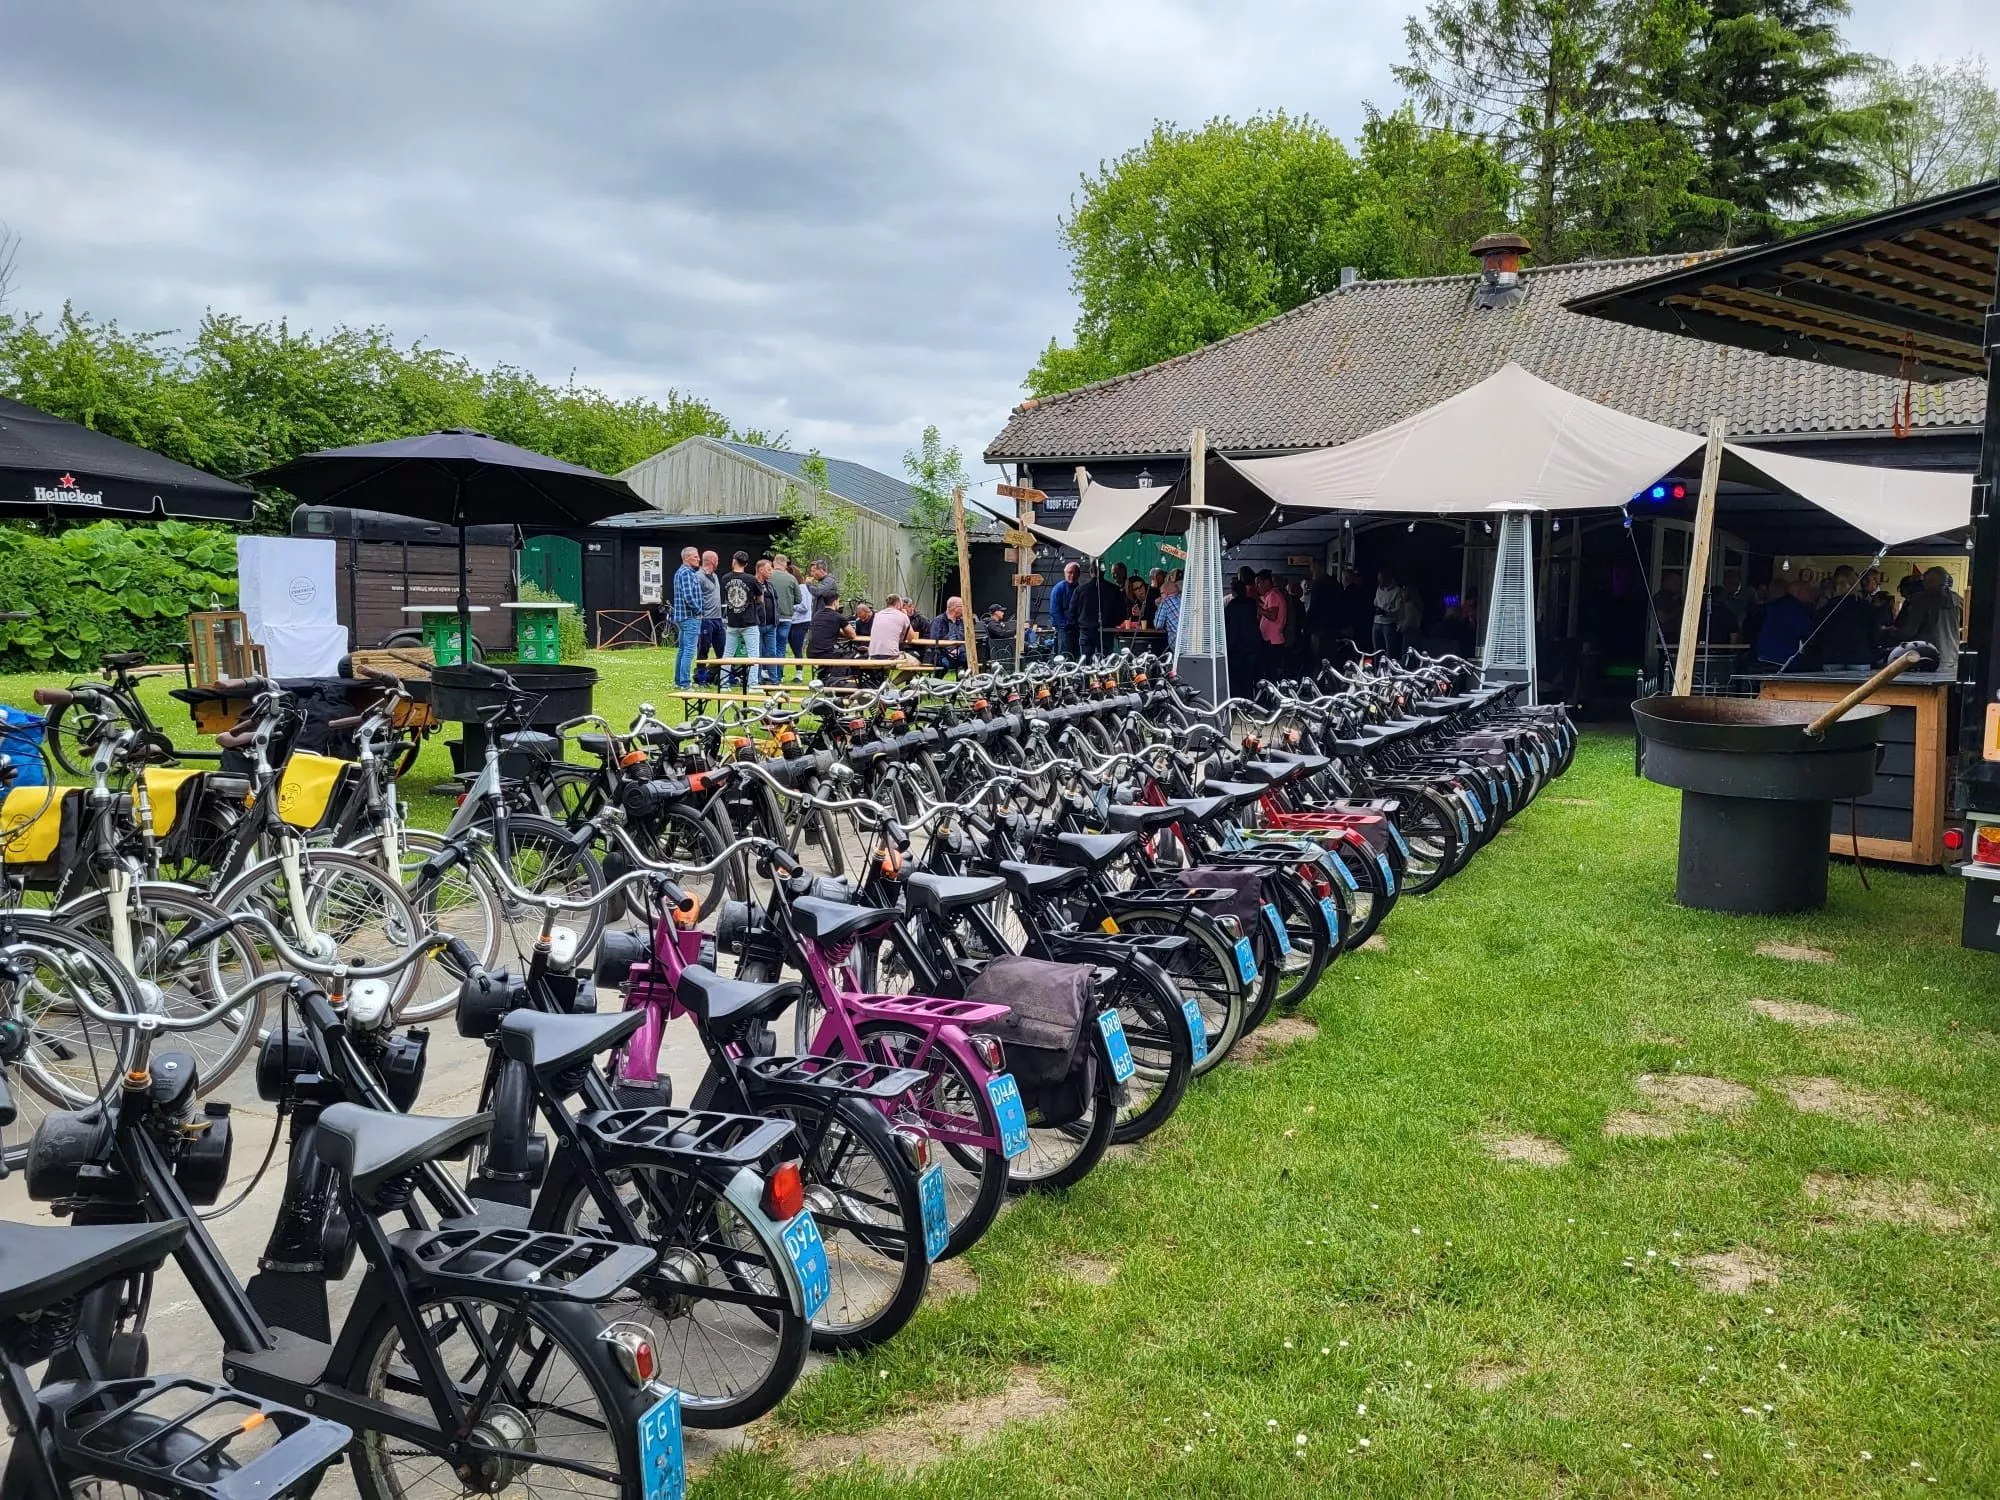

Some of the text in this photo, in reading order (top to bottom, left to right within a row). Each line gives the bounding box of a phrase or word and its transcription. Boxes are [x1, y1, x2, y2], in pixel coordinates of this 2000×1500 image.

[34, 487, 103, 505] Heineken
[1102, 1014, 1120, 1038] DRB
[991, 1081, 1016, 1106] DH4
[645, 1401, 676, 1451] FG1
